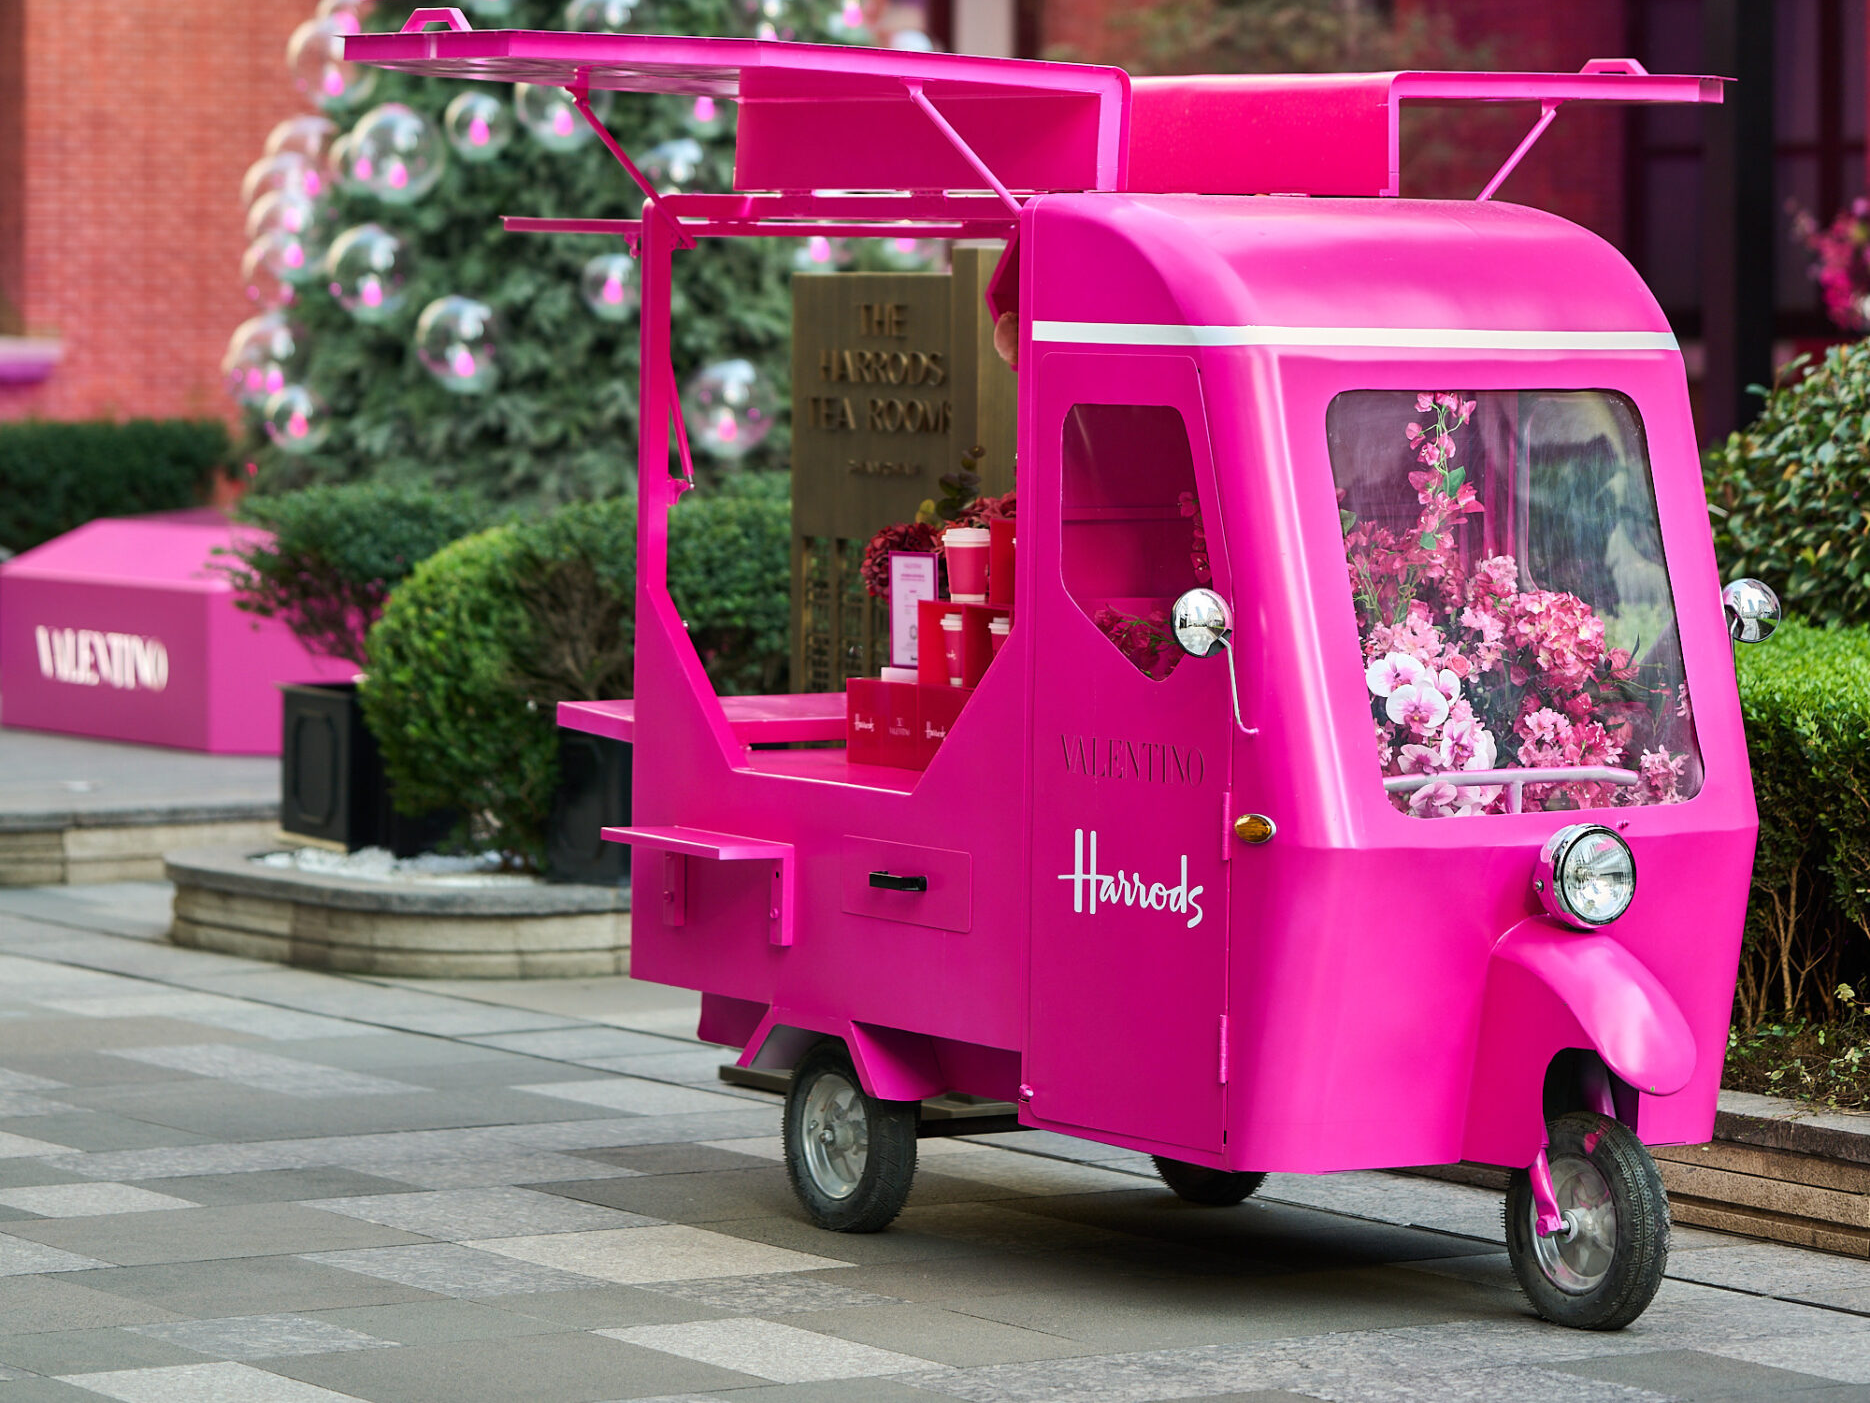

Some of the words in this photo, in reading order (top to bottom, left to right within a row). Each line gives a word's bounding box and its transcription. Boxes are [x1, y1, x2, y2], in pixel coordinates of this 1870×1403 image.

[858, 303, 908, 339] THE
[819, 350, 946, 387] HARRODS
[808, 397, 857, 433] TEA
[1060, 733, 1205, 788] VALENTINO
[1057, 828, 1204, 929] Harrods
